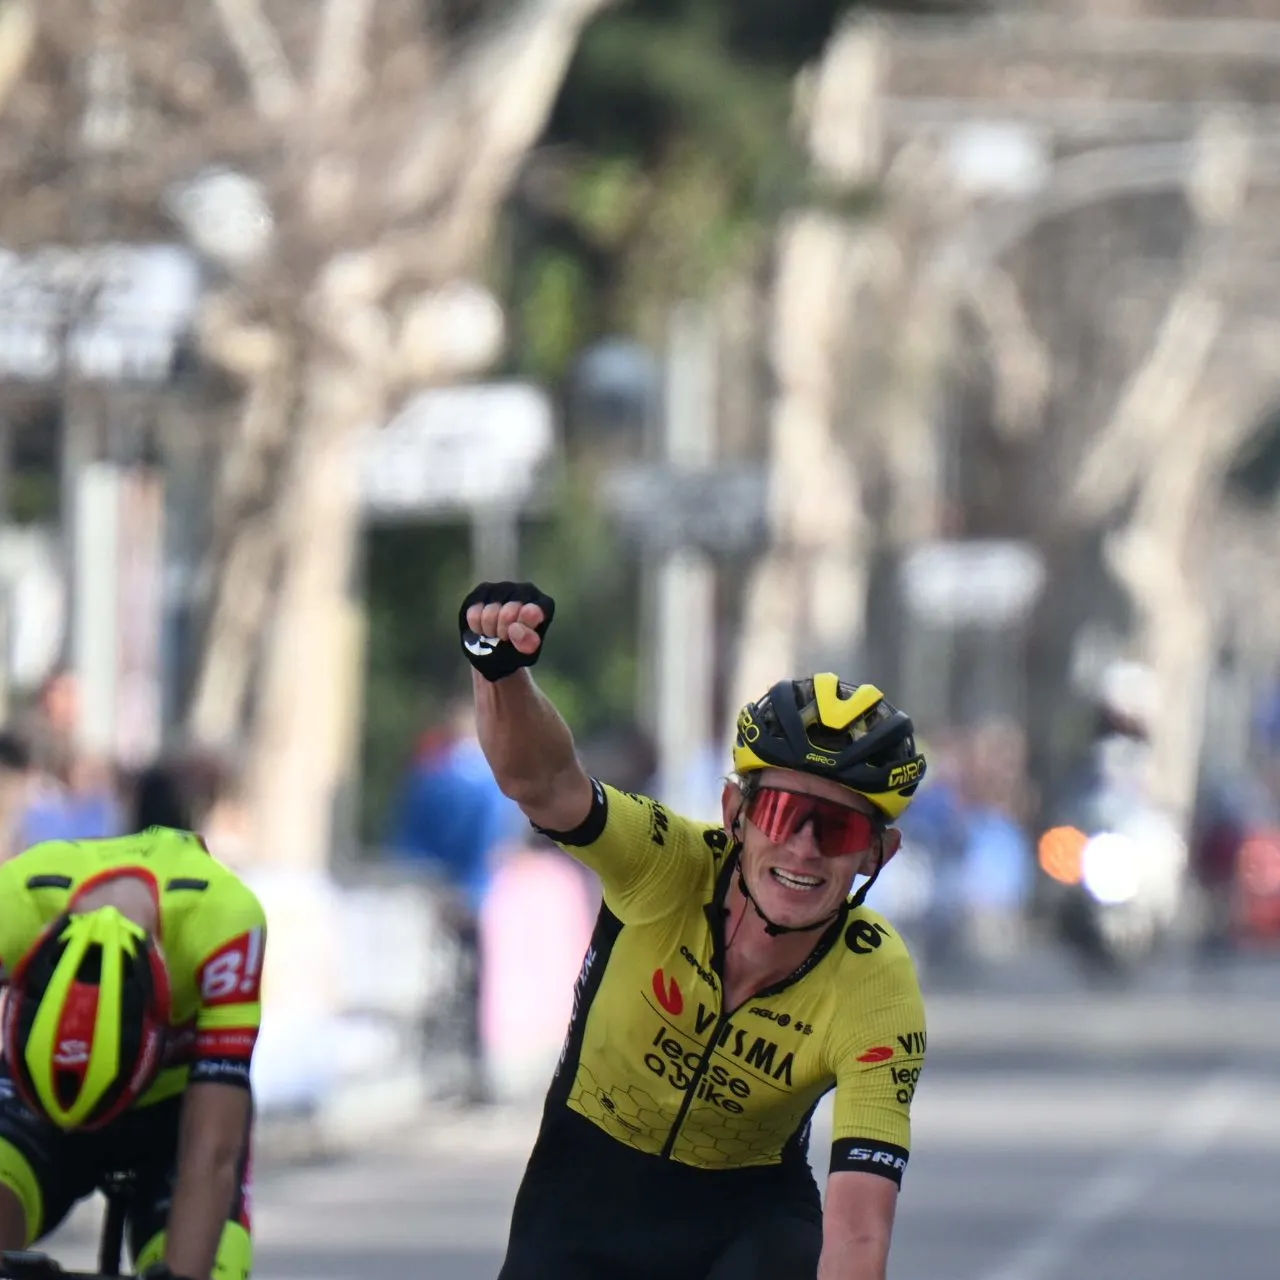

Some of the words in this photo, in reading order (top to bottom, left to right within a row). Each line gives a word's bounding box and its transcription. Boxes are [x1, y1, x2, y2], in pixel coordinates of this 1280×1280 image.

[806, 752, 836, 767] GIRO
[201, 924, 263, 999] B!
[748, 1005, 780, 1021] AGU
[652, 1025, 752, 1099] lease
[694, 1002, 795, 1087] VISMA
[847, 1148, 908, 1172] SRA
